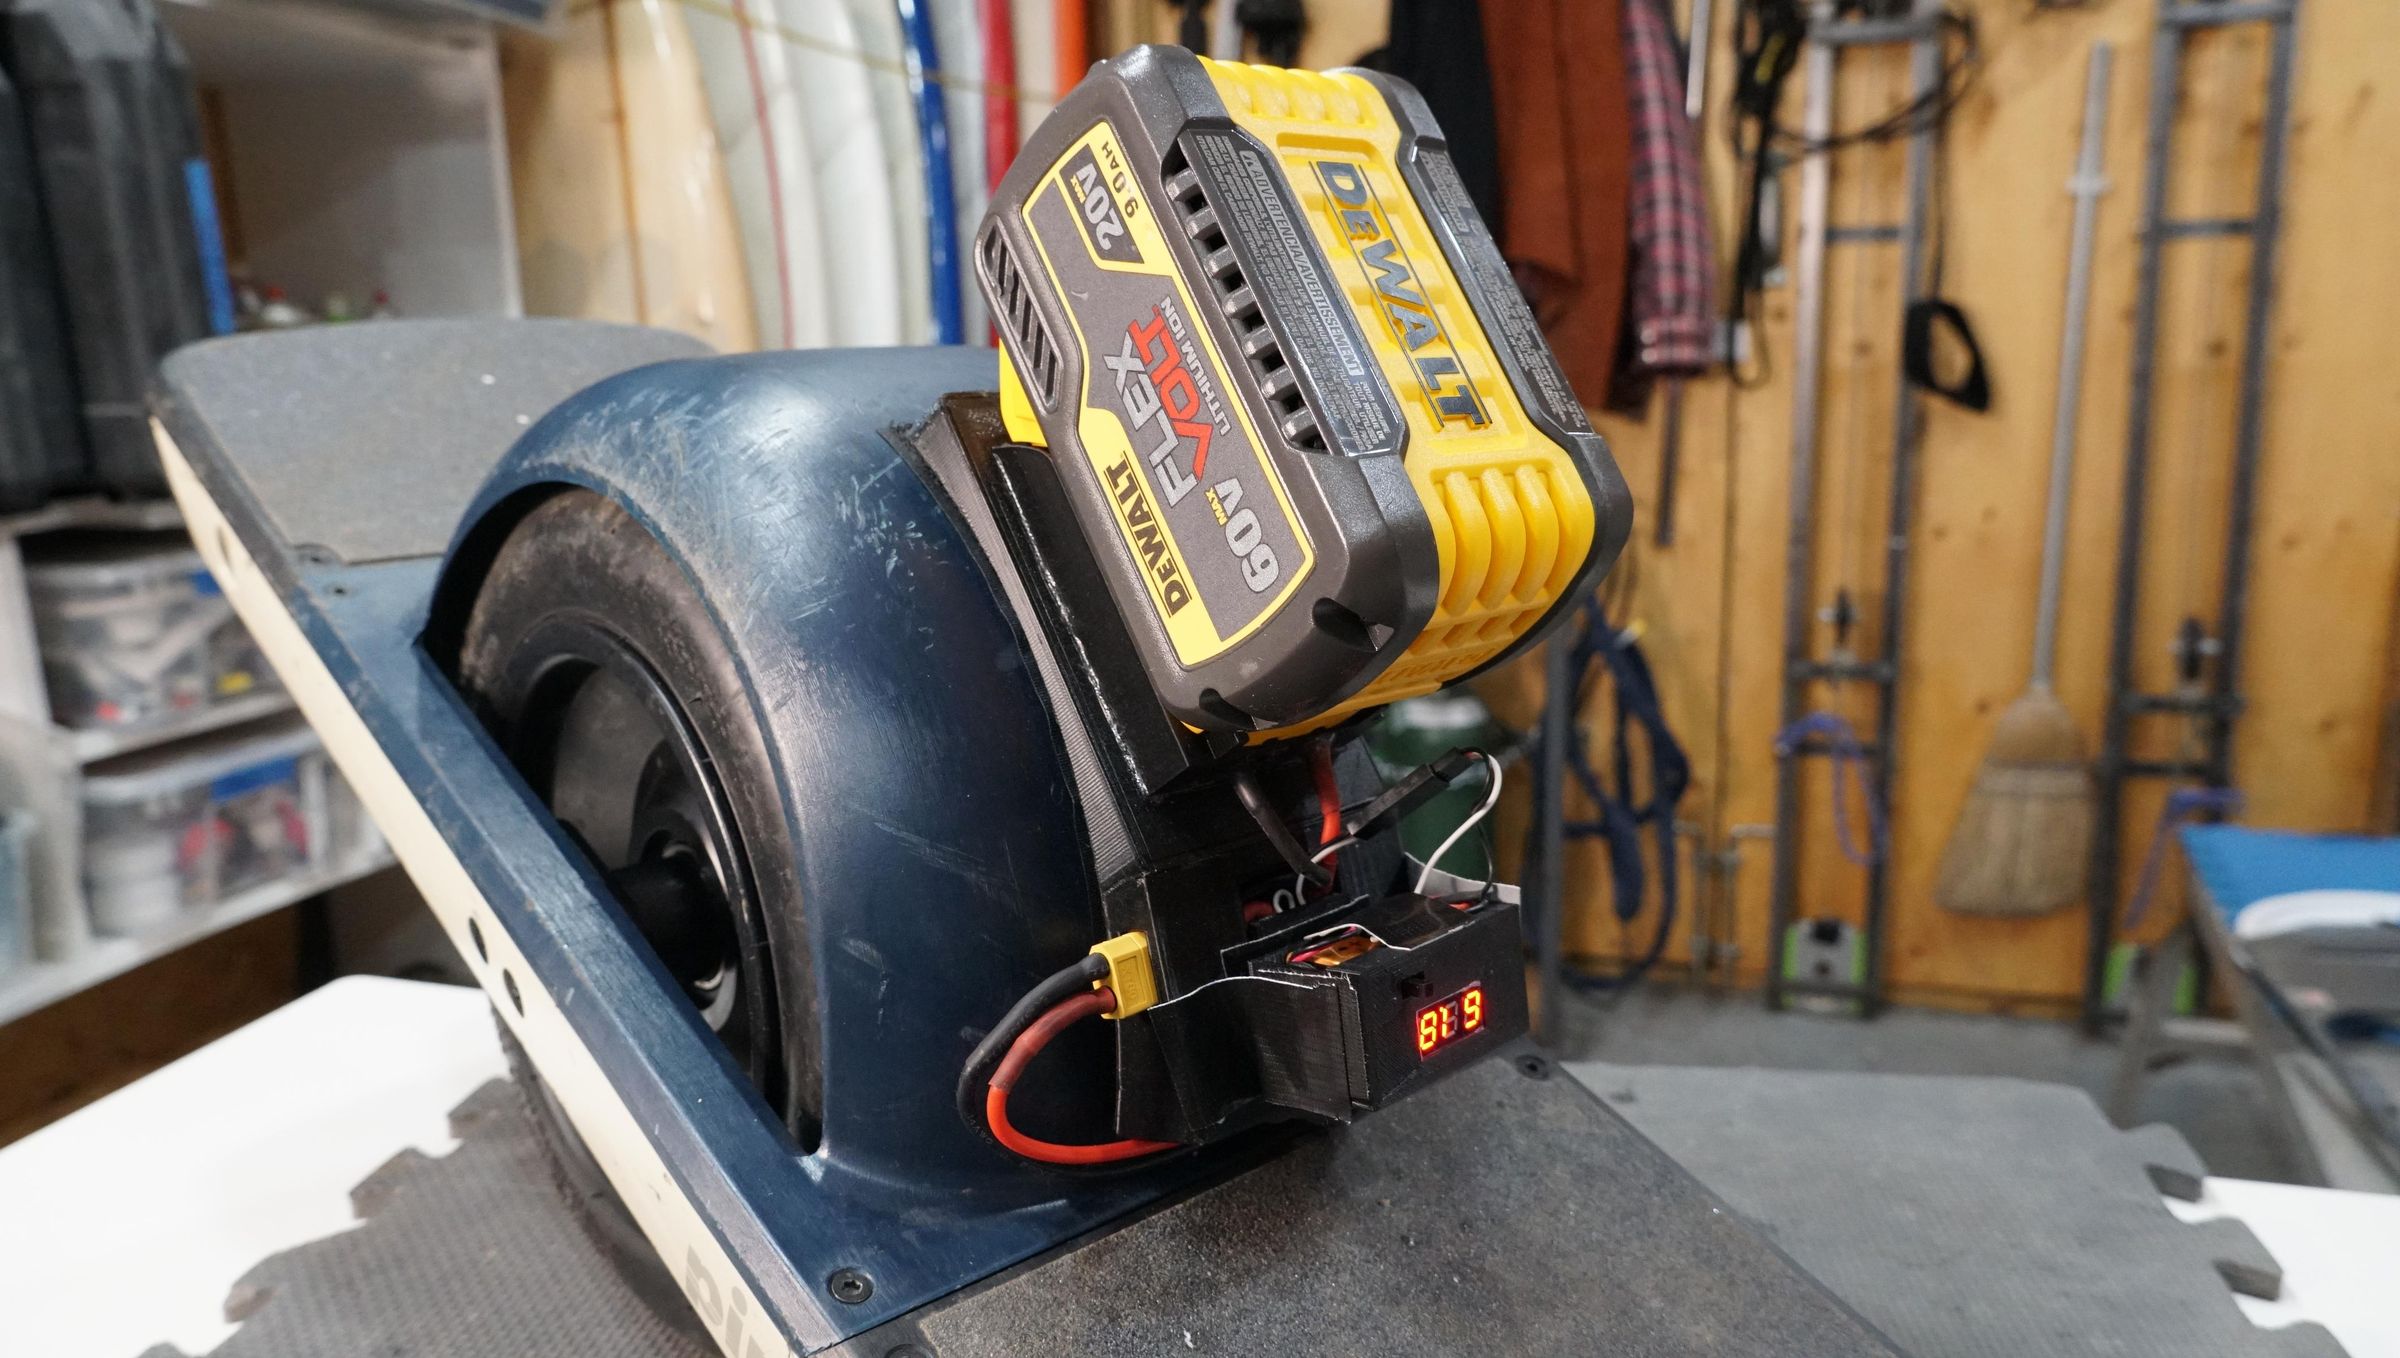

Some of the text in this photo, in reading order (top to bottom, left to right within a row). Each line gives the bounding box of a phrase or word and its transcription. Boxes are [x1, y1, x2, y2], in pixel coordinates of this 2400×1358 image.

[1070, 174, 1089, 203] MAX
[1075, 162, 1126, 251] 20V
[1316, 160, 1486, 427] DEWALT
[1103, 328, 1199, 509] FLEX
[1129, 316, 1216, 482] VOLT
[1161, 295, 1232, 438] LITHIUM ION
[1104, 453, 1192, 619] DEWALT
[1206, 486, 1229, 528] MAX
[1213, 476, 1280, 594] 60V
[686, 1244, 766, 1358] pi
